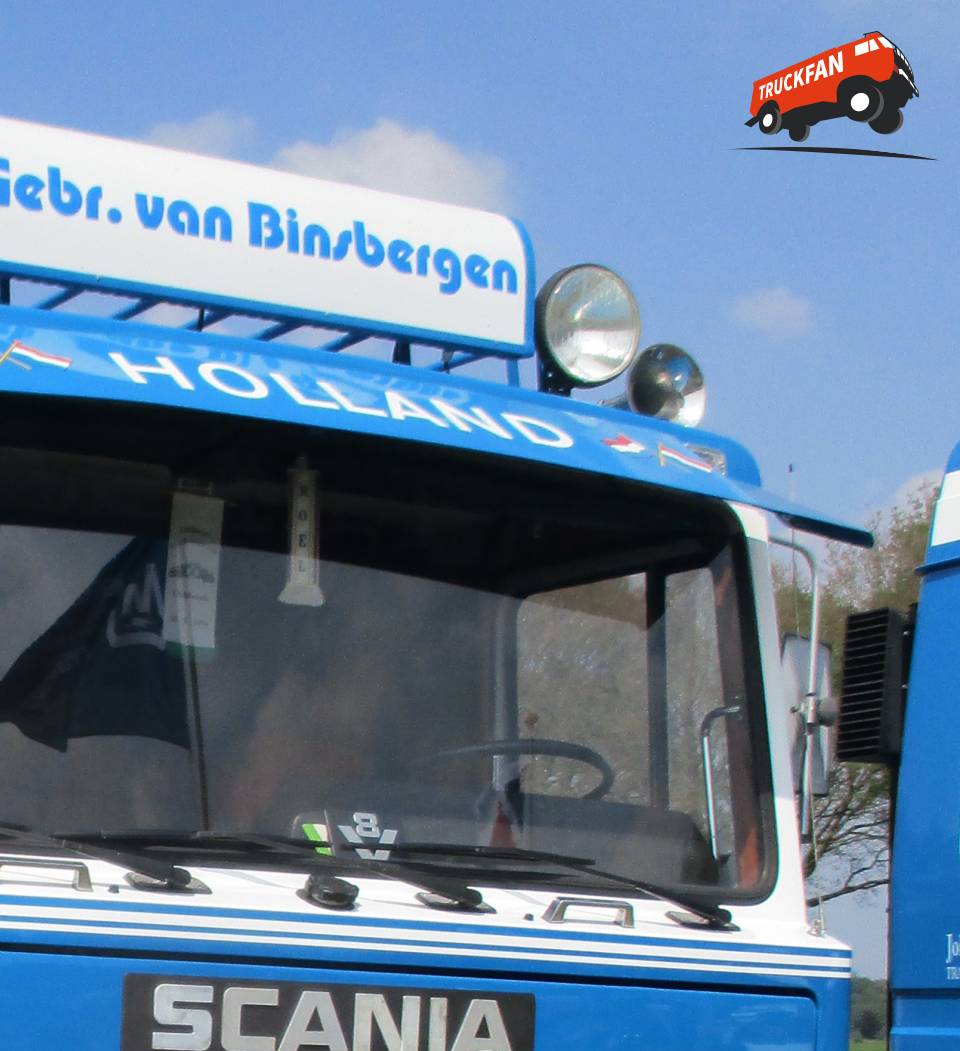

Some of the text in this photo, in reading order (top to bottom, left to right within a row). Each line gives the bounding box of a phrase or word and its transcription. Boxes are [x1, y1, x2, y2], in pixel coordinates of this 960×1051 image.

[134, 191, 233, 242] van
[246, 201, 519, 295] Binsbergen
[108, 351, 575, 449] HOLLAND
